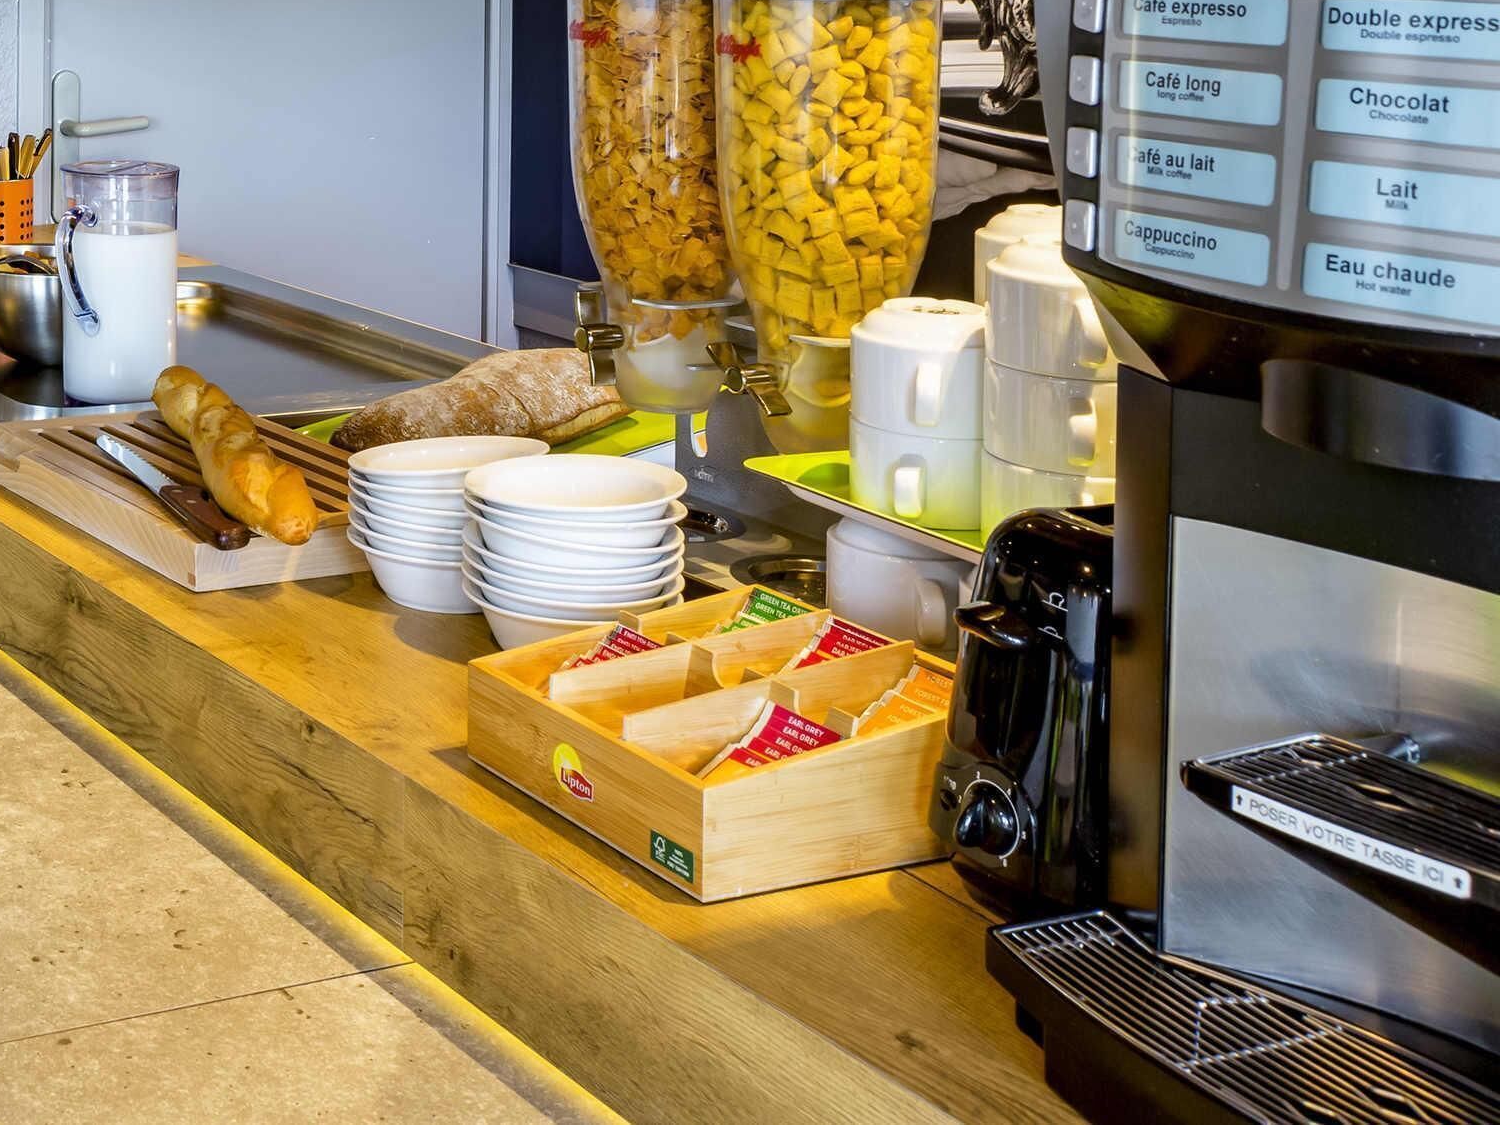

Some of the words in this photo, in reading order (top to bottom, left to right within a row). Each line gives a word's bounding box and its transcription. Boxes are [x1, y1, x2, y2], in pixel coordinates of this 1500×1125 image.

[1171, 0, 1248, 18] expresso
[1161, 17, 1202, 27] Espresso
[1327, 7, 1401, 27] Double
[1408, 14, 1500, 33] express
[1360, 29, 1401, 41] Double
[1404, 31, 1461, 44] espresso
[1145, 71, 1181, 90] Café
[1186, 74, 1221, 97] long
[1178, 93, 1205, 103] coffee
[1349, 87, 1450, 114] Chocolat
[1369, 109, 1429, 125] Chocolate
[1165, 155, 1185, 168] au
[1190, 153, 1216, 172] lait
[1146, 166, 1164, 176] Milk
[1165, 169, 1192, 180] coffee
[1376, 178, 1419, 200] Lait
[1385, 199, 1409, 210] Milk
[1124, 220, 1218, 251] Cappuccino
[1144, 243, 1195, 260] Cappuccino
[1325, 253, 1365, 276] Eau
[1373, 262, 1456, 289] chaude
[1355, 279, 1377, 292] Hot
[1380, 284, 1412, 296] water
[782, 726, 799, 740] EARL
[799, 734, 820, 747] GREY
[787, 716, 804, 730] EARL
[804, 724, 825, 738] GREY
[775, 737, 792, 751] EARL
[562, 768, 591, 797] Lipton
[1249, 798, 1299, 830] POSER
[1303, 820, 1356, 854] VOTRE
[1362, 842, 1416, 874] TASSE
[1421, 864, 1445, 885] ICI
